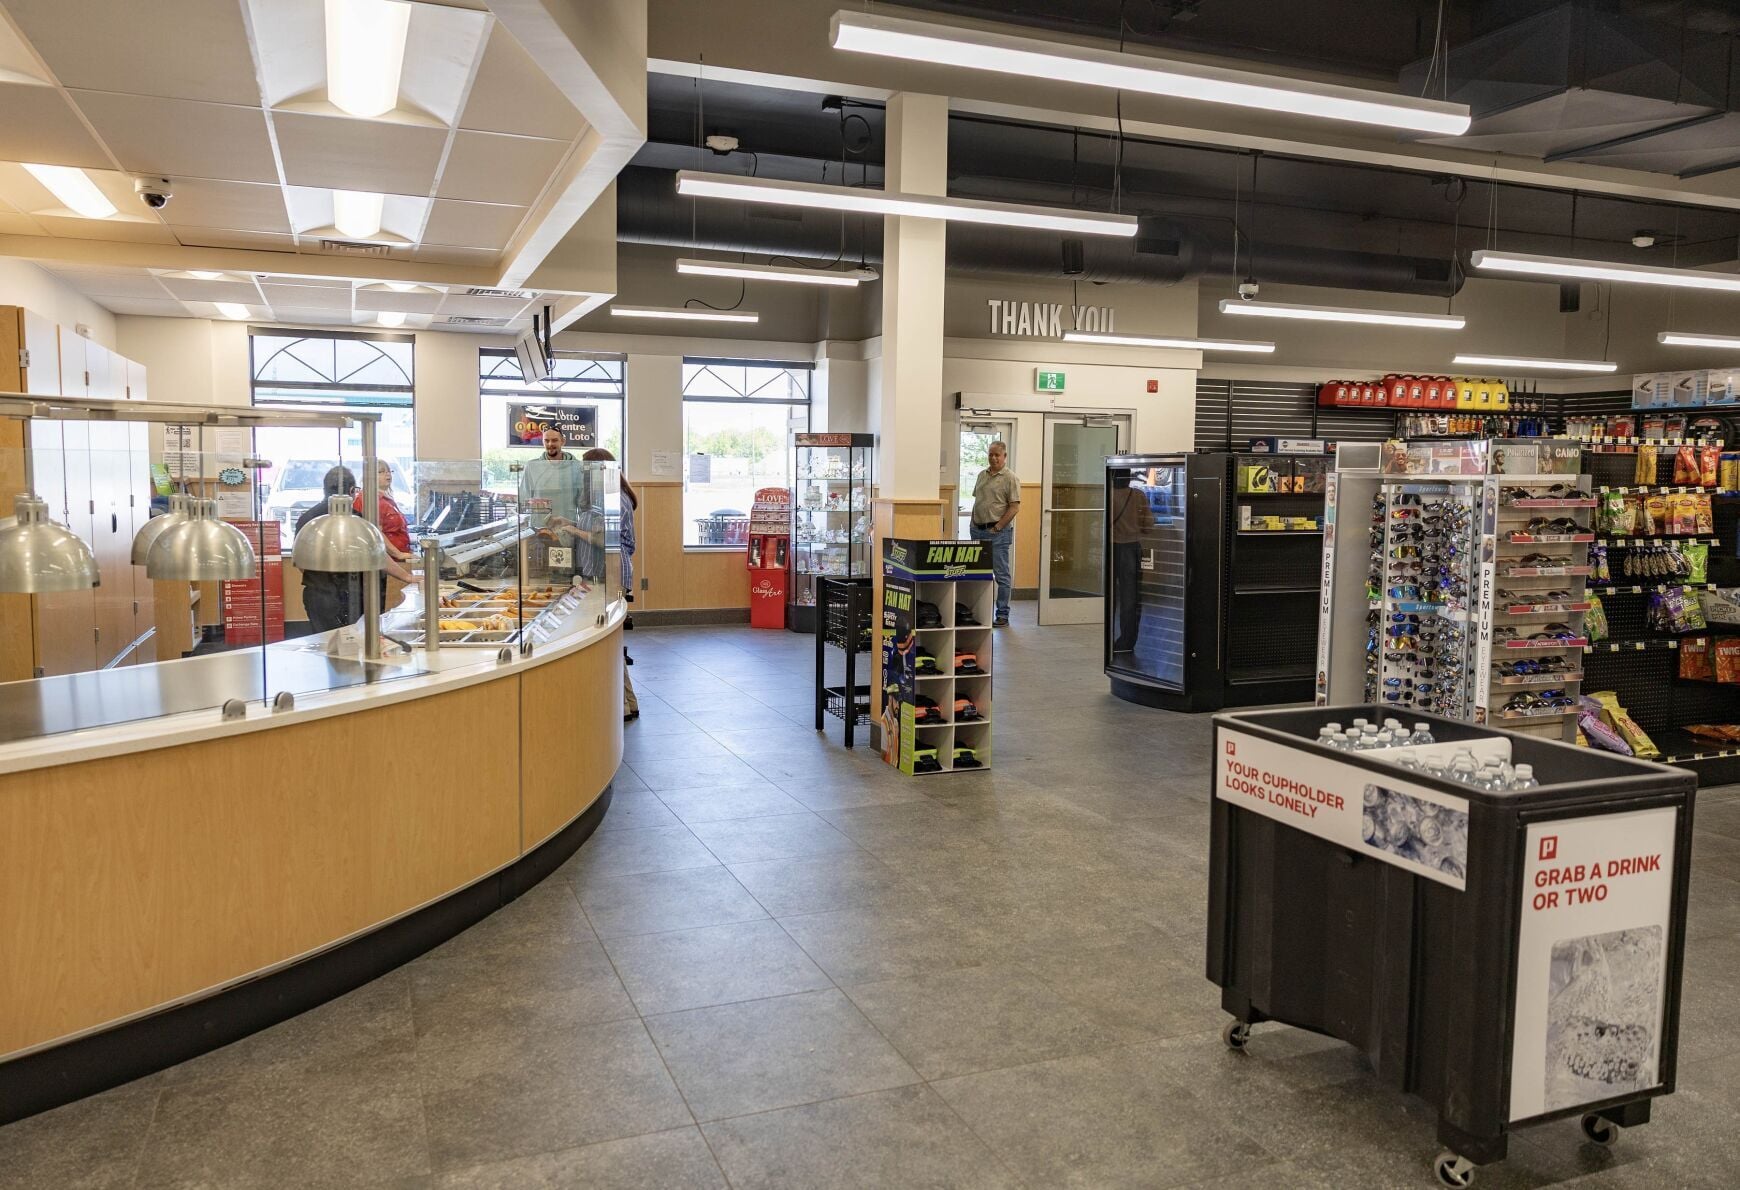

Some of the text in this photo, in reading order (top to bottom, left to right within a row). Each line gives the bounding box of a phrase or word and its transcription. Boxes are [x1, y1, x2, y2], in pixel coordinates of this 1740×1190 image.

[987, 299, 1115, 338] THANK YOU
[555, 410, 580, 421] Lotto
[570, 433, 590, 441] Loto
[1555, 448, 1579, 458] CAMO
[762, 495, 784, 503] LOVE
[927, 546, 954, 563] FAN
[955, 546, 983, 563] HAT
[1322, 553, 1331, 614] PREMIUM
[885, 589, 912, 612] FAN HAT
[1480, 569, 1491, 641] PREMIUM
[1225, 775, 1318, 818] LOOKS LONELY
[1226, 759, 1345, 811] YOUR CUPHOLDER
[1535, 853, 1661, 888] GRAB A DRINK
[1532, 884, 1608, 911] OR TWO
